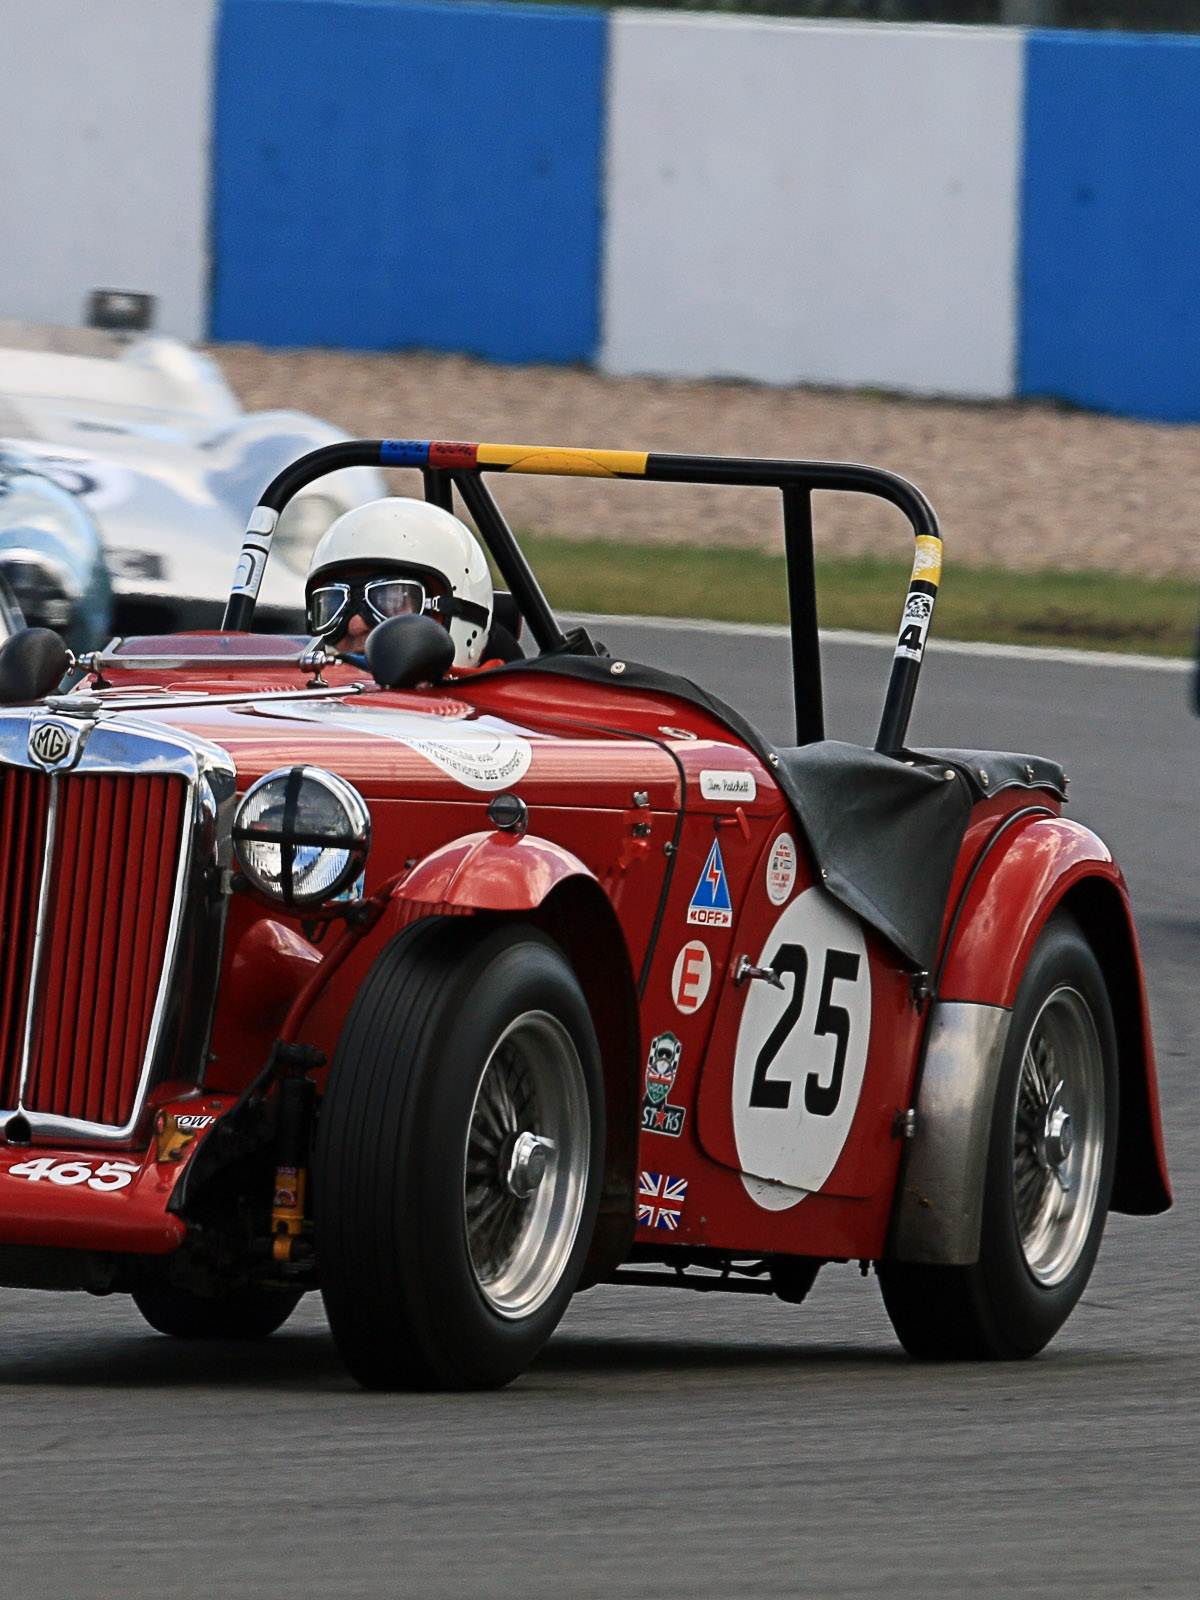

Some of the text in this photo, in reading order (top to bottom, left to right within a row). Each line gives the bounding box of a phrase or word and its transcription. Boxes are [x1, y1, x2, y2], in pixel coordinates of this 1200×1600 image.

[898, 624, 922, 651] 4
[36, 728, 64, 757] MG
[698, 909, 722, 924] OFF
[677, 948, 704, 1008] E
[749, 943, 861, 1116] 25
[8, 1157, 141, 1191] 465
